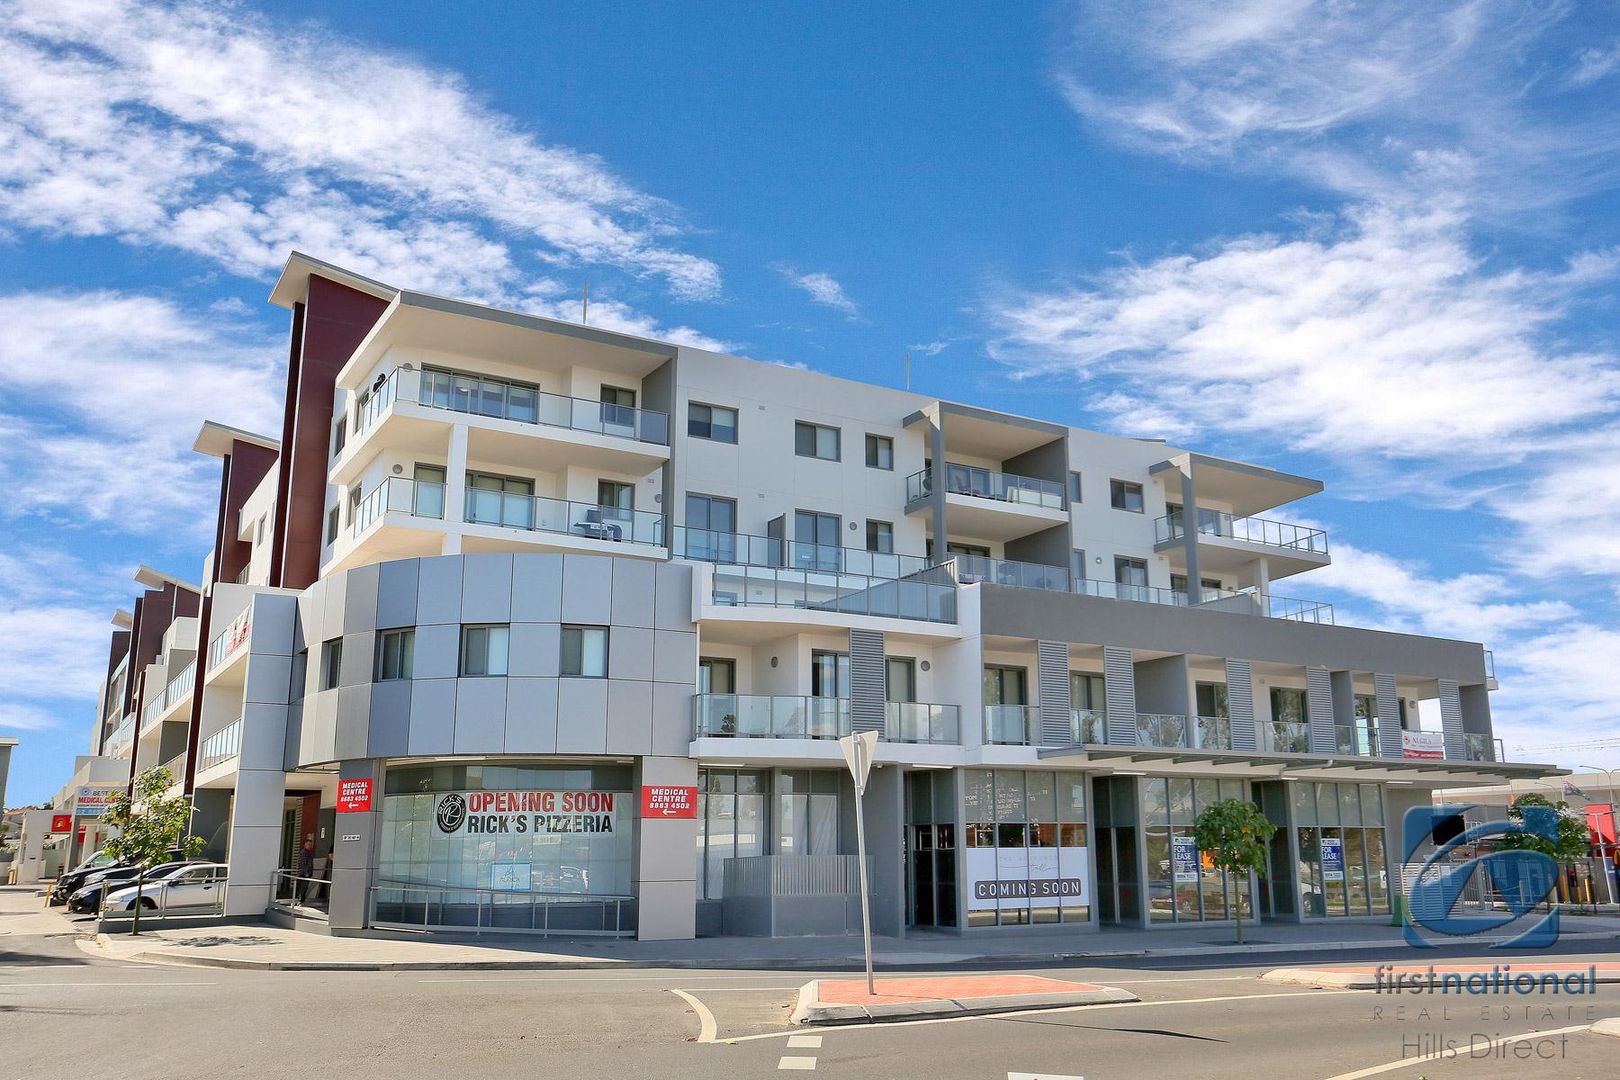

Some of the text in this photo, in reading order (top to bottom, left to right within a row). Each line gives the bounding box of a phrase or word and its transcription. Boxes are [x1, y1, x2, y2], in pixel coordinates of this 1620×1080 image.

[342, 781, 368, 789] MEDICAL
[342, 788, 366, 796] CENTRE
[651, 788, 689, 796] MEDICAL
[469, 792, 614, 812] OPENING SOON
[468, 814, 527, 833] RICK'S
[534, 814, 613, 833] PIZZERIA
[978, 881, 1080, 896] COMING SOON
